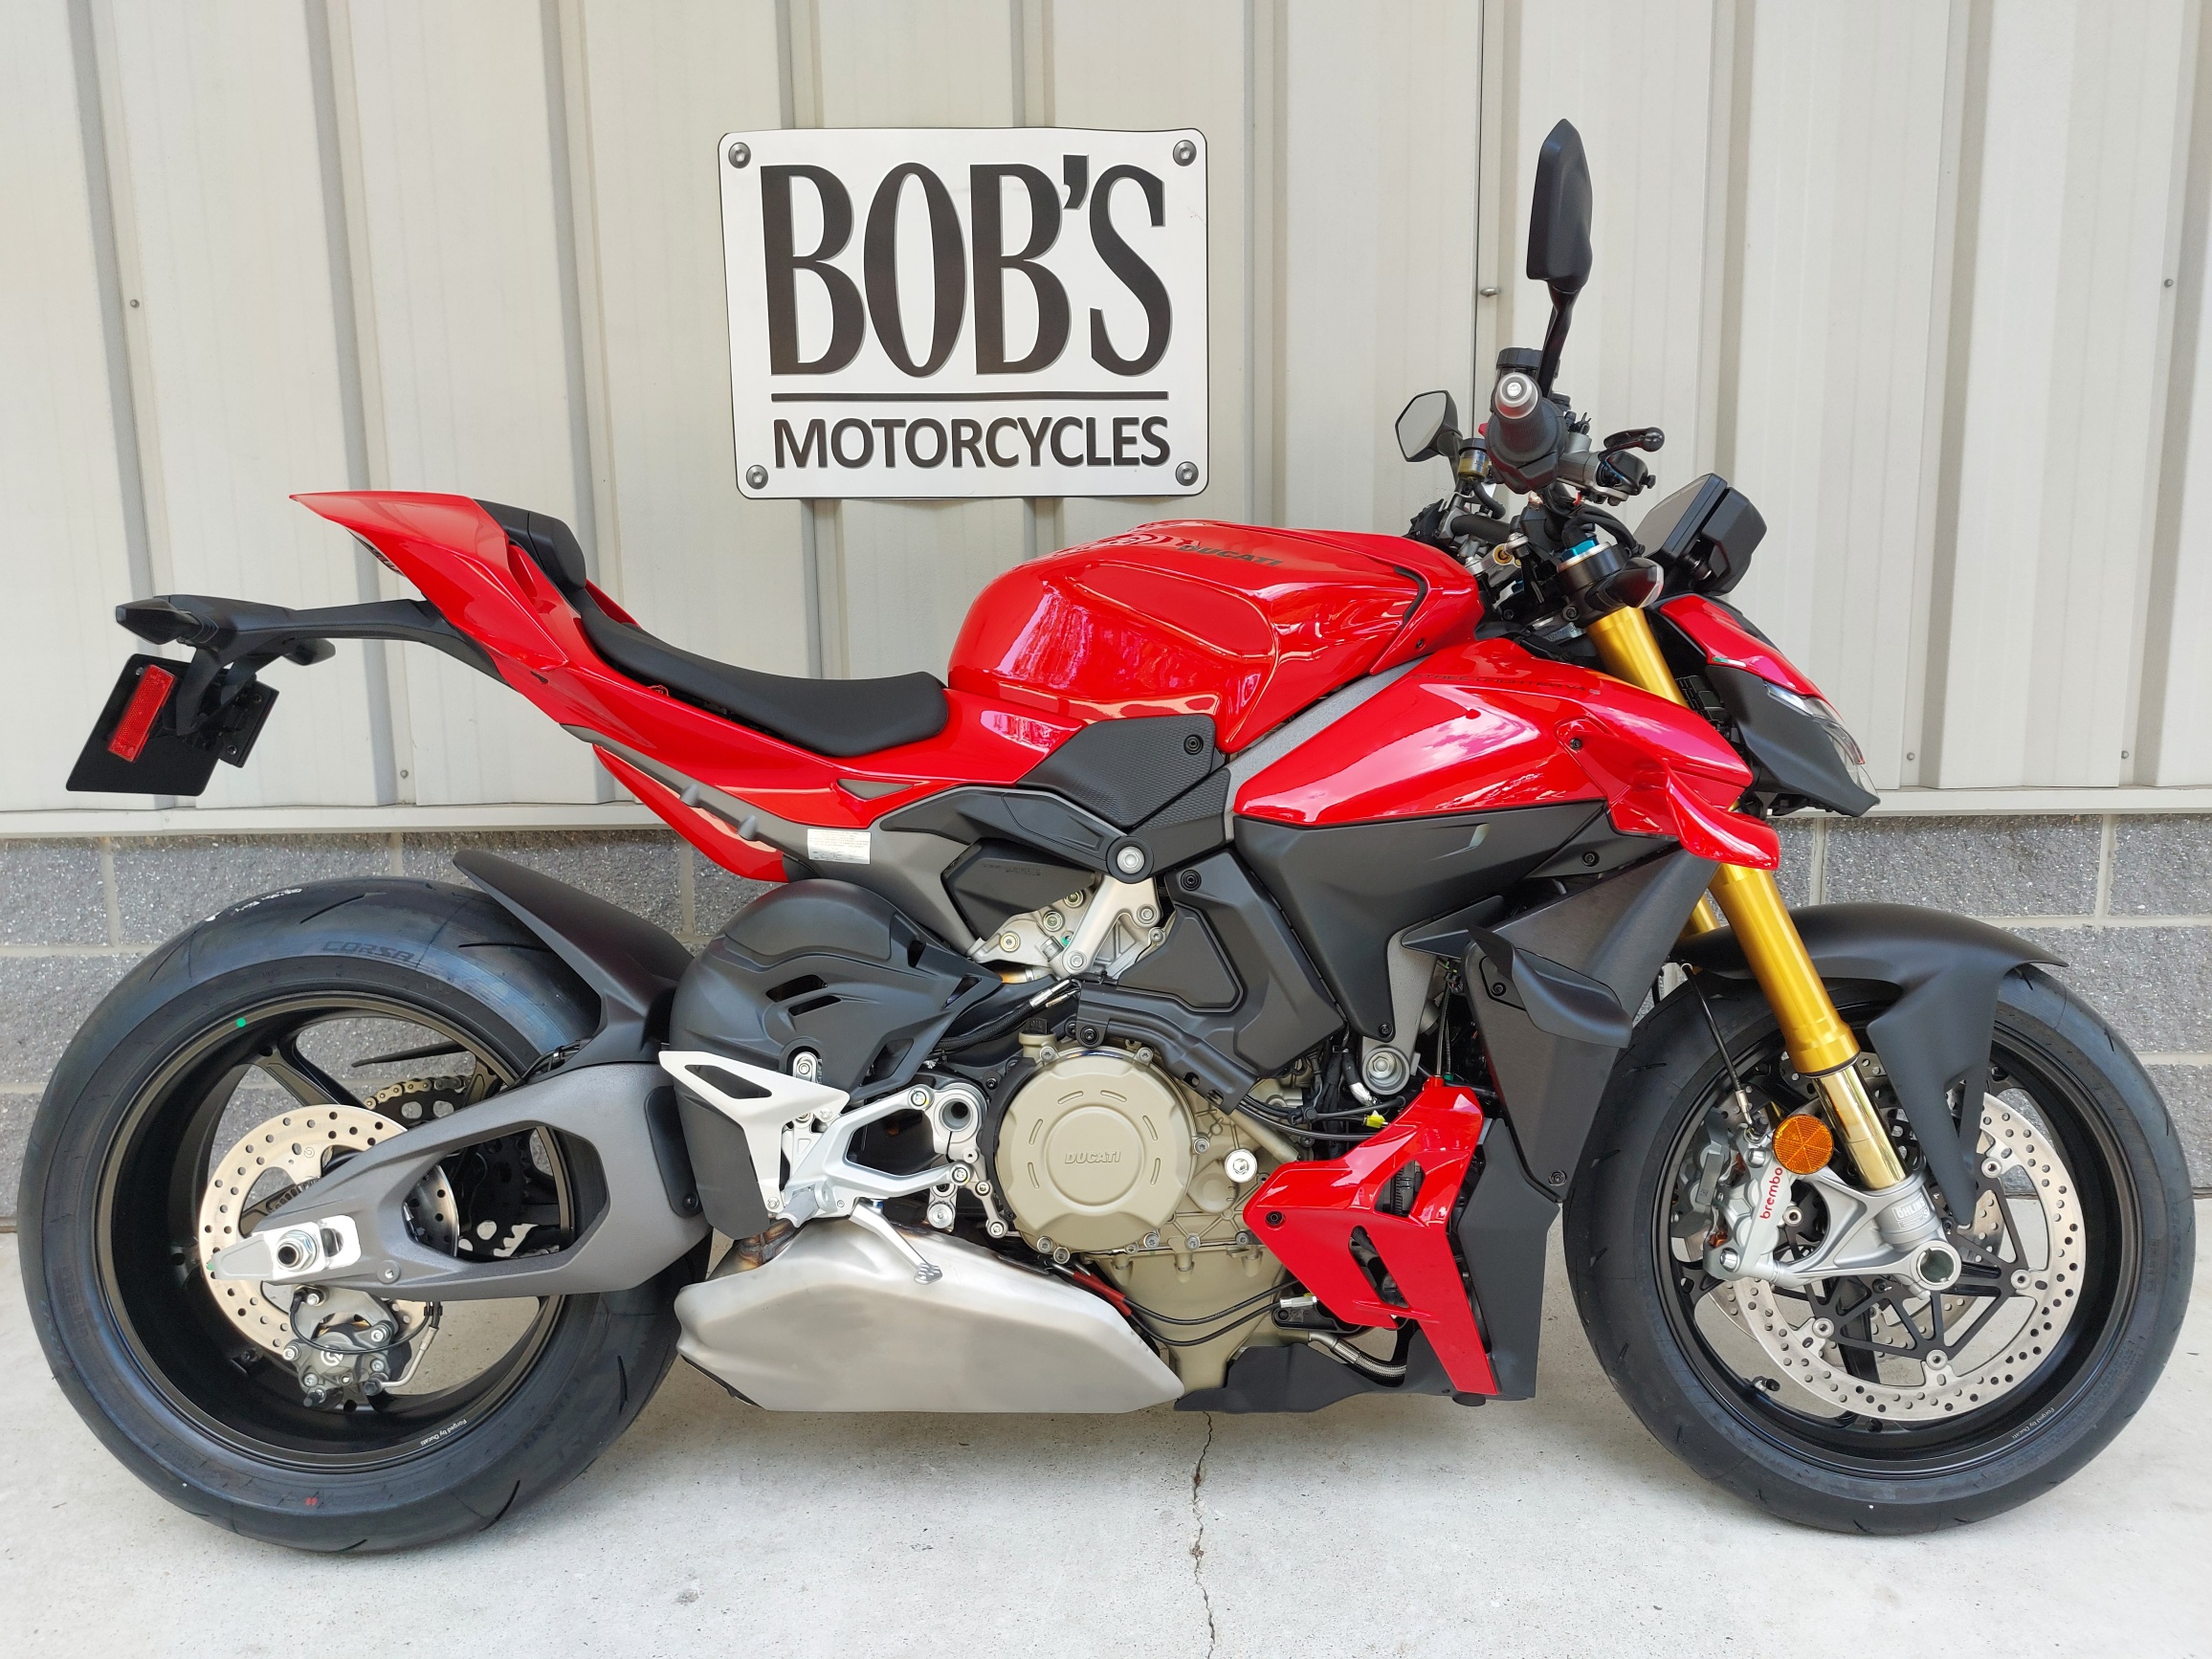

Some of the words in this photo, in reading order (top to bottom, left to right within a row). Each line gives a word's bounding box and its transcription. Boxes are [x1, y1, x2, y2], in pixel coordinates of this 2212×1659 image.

[761, 154, 1172, 378] BOB'S
[773, 416, 1171, 469] MOTORCYCLES
[1177, 544, 1283, 566] DUCATI
[323, 940, 415, 962] CORSA
[1064, 1150, 1121, 1164] DUCATI
[1759, 1166, 1783, 1220] brembo
